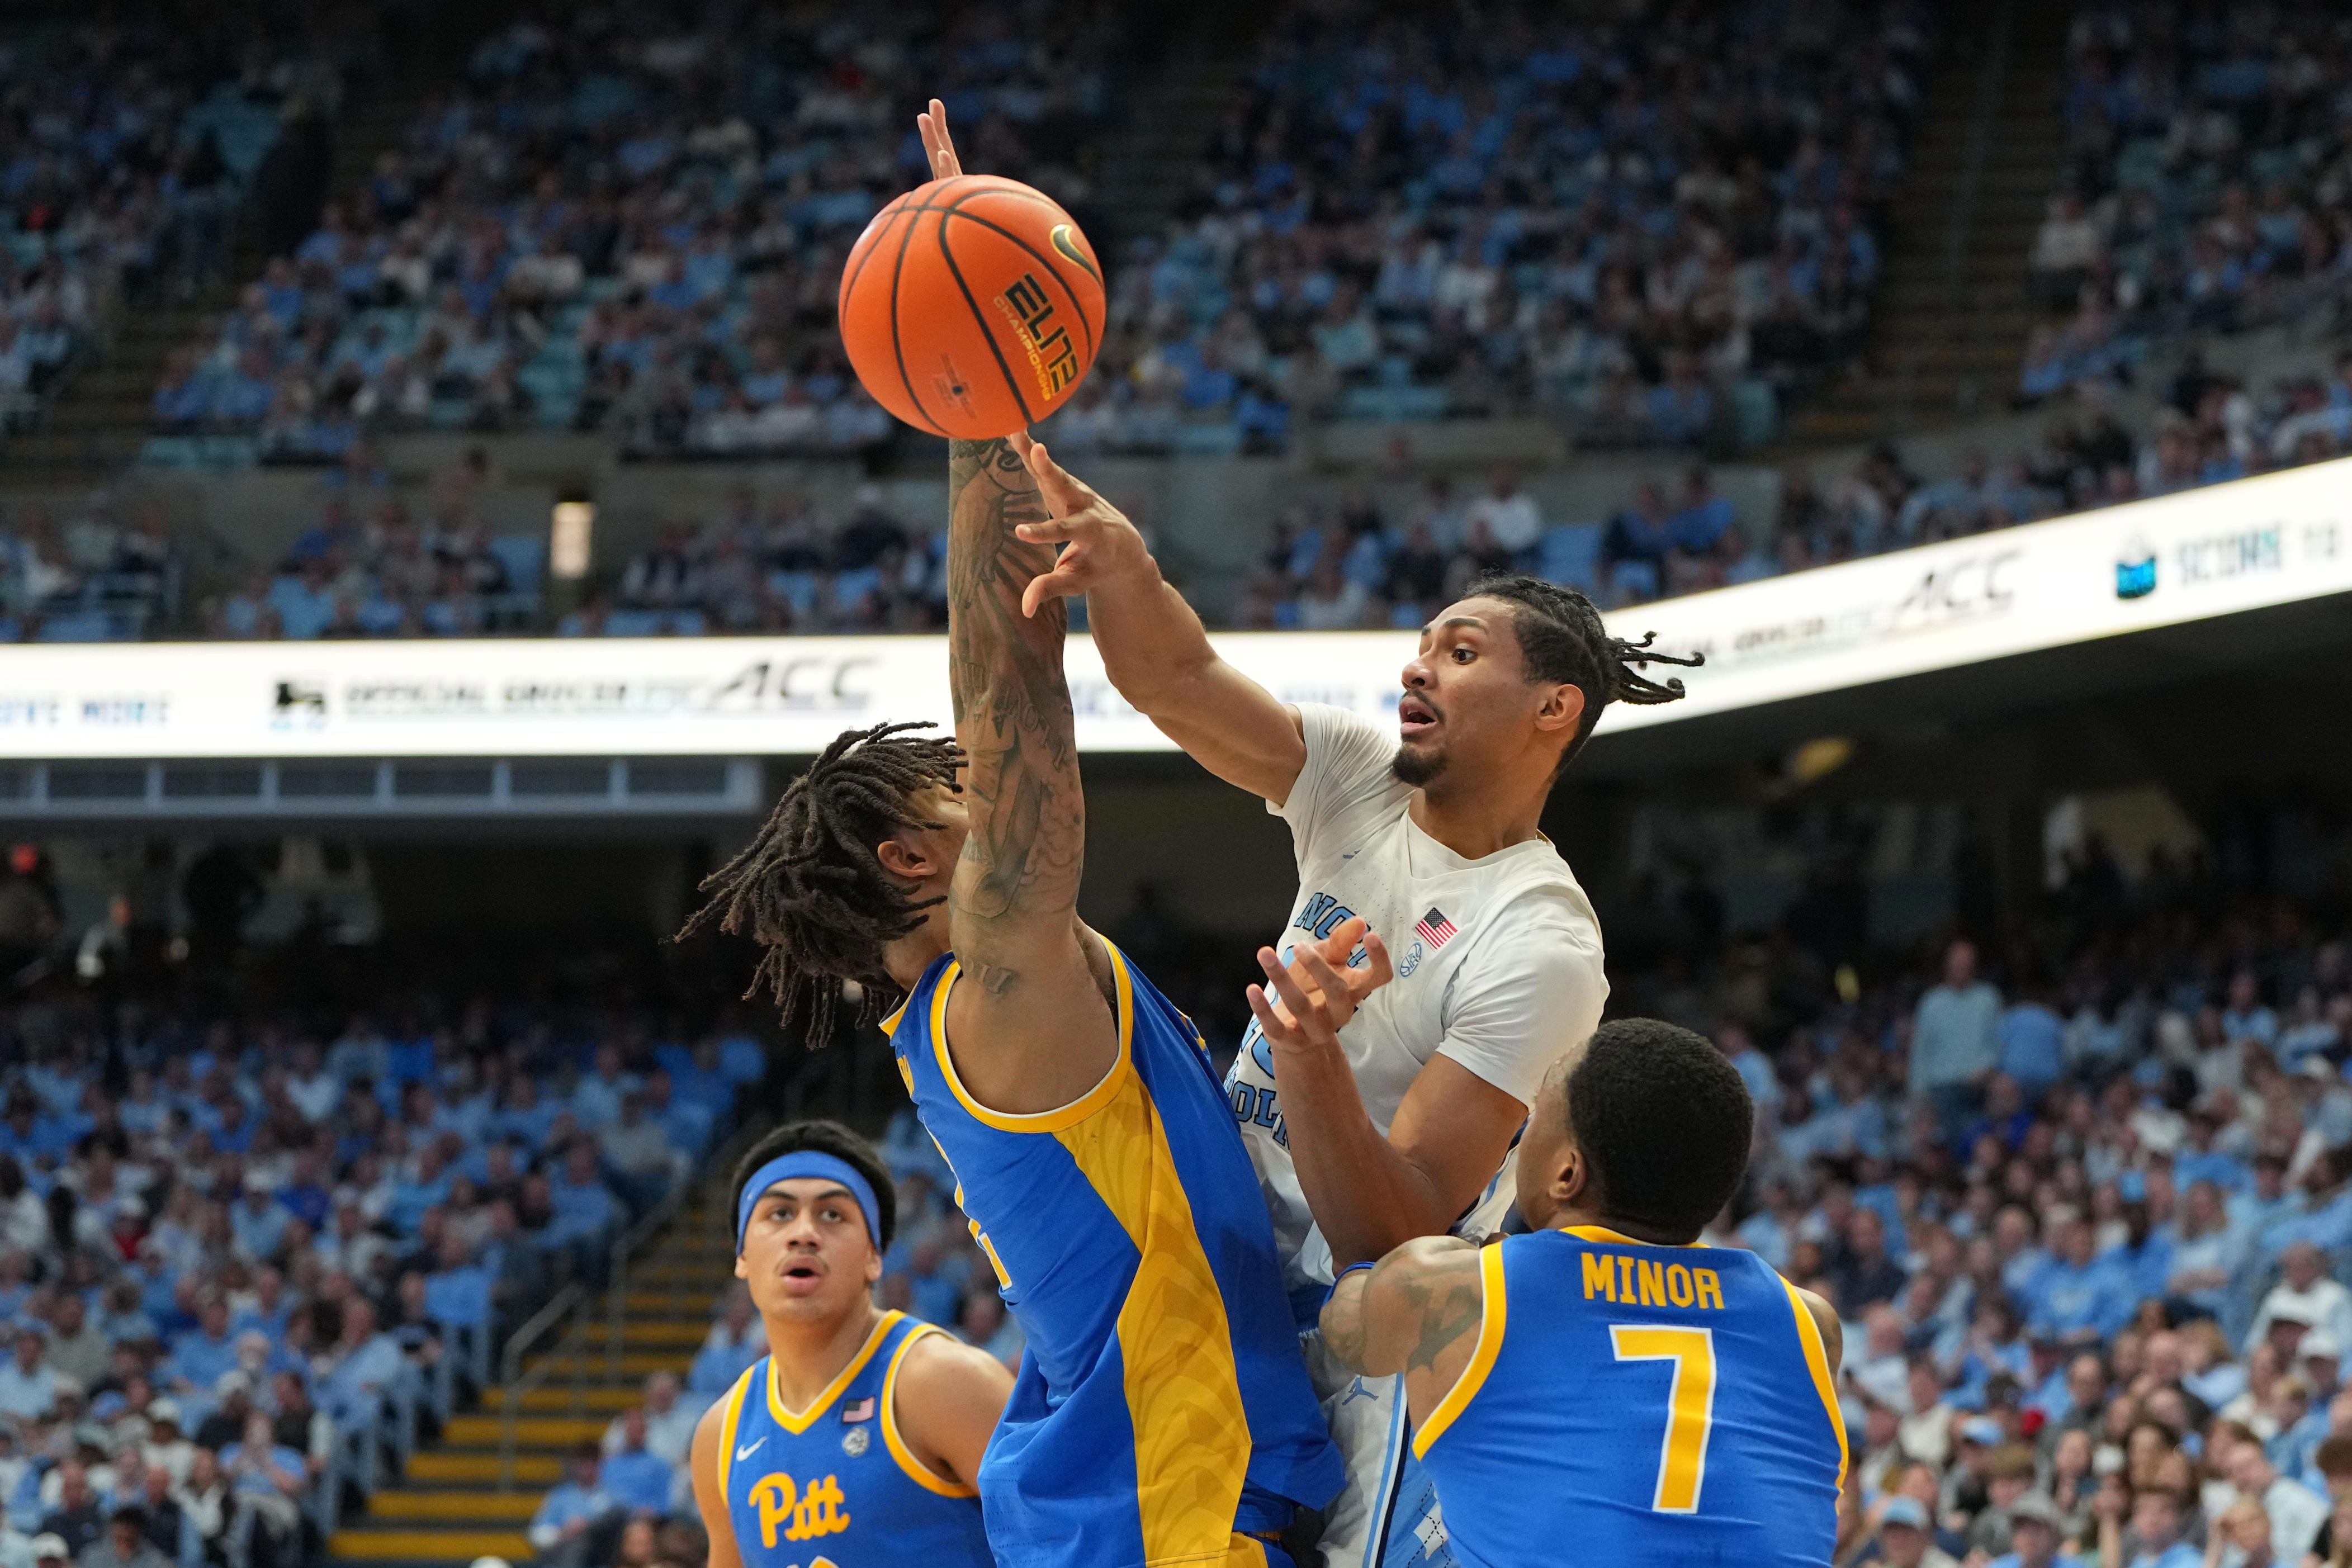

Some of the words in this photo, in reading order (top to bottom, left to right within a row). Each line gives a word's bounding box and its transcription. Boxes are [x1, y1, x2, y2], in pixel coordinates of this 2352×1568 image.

[1004, 271, 1079, 396] ELITE
[707, 655, 881, 705] ACC
[1580, 1252, 1725, 1309] MINOR
[1608, 1324, 1716, 1514] 7
[748, 1471, 850, 1548] Pitt
